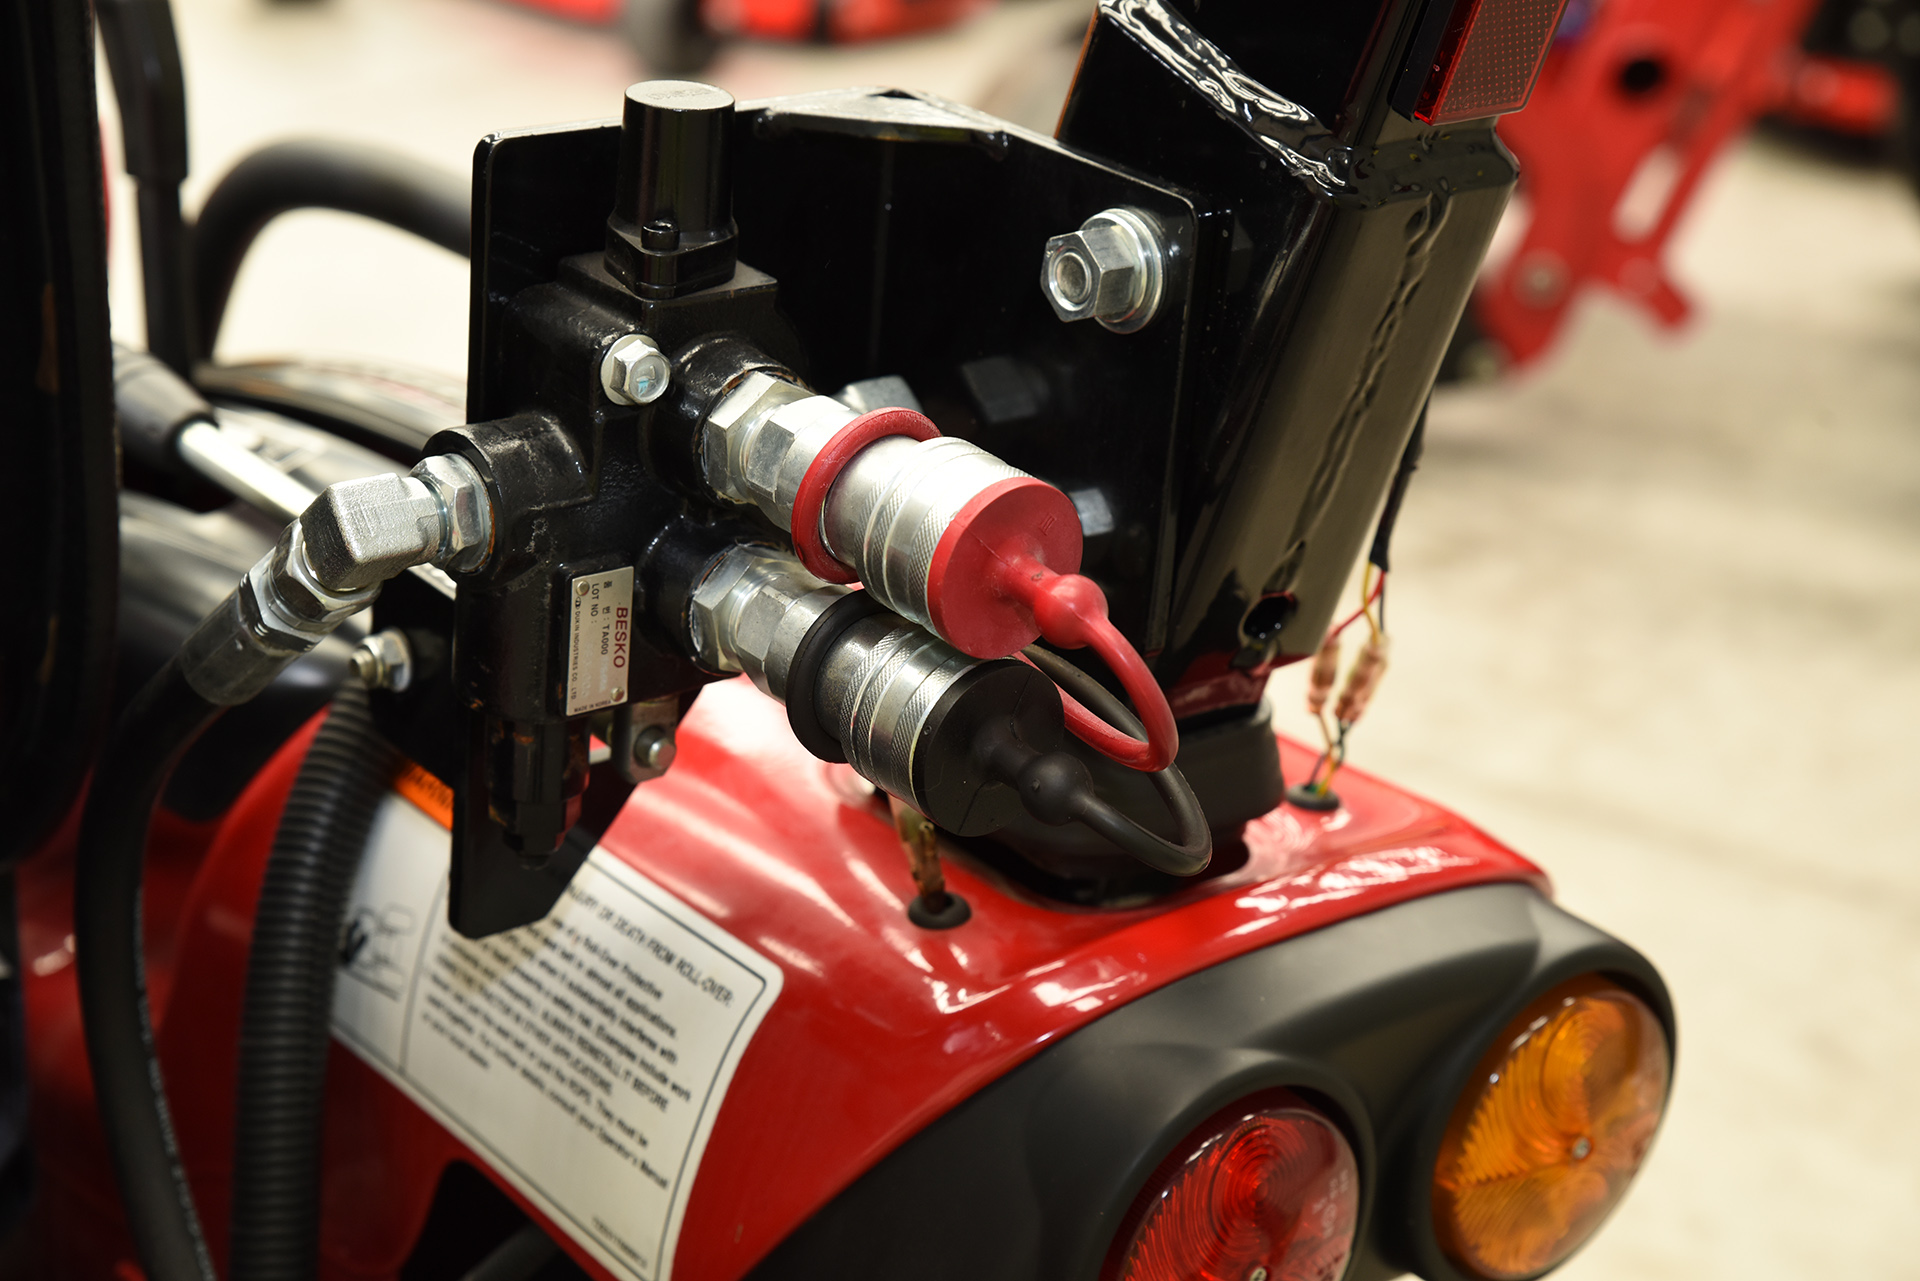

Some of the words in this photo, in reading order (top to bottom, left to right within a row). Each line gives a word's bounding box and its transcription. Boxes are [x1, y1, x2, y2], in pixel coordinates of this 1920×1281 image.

[591, 583, 599, 600] LOT
[603, 580, 612, 588] 품
[591, 604, 598, 617] NO
[602, 606, 611, 614] 번
[601, 624, 610, 655] TA000
[613, 607, 628, 668] BESKO
[647, 939, 673, 965] FROM
